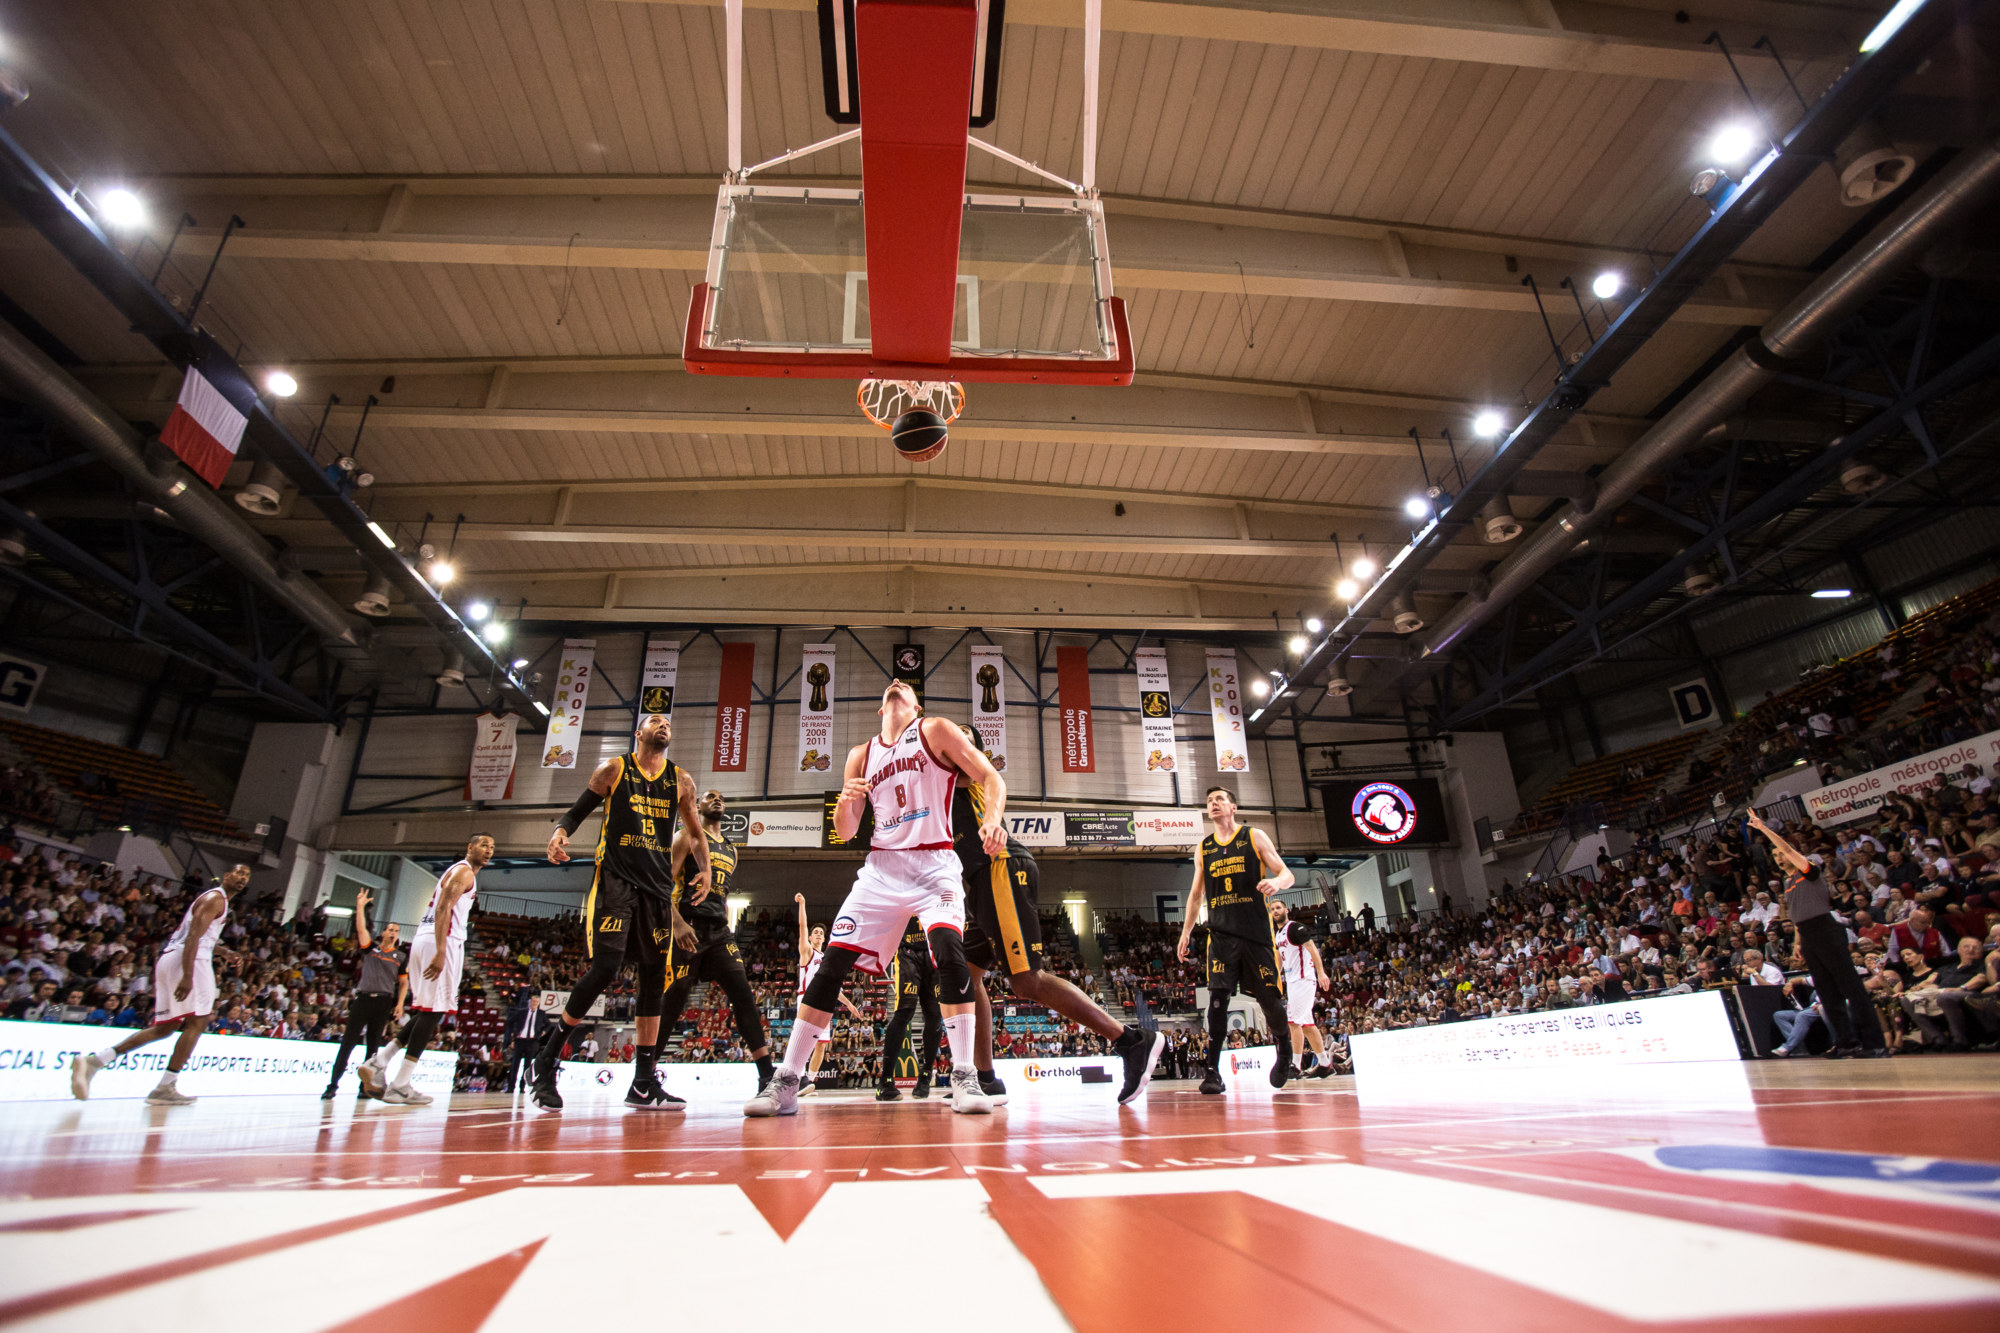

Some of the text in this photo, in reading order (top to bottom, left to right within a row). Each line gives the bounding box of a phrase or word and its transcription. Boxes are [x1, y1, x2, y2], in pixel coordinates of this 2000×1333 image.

[568, 666, 588, 727] 2002
[1225, 674, 1241, 732] 2002
[1673, 684, 1713, 724] D
[492, 730, 502, 742] 7
[718, 706, 733, 766] métropole
[730, 707, 747, 766] GrandNancy
[805, 729, 827, 737] 2008
[806, 737, 827, 746] 2011
[980, 730, 1000, 738] 2008
[984, 738, 1001, 746] 011
[1063, 708, 1078, 767] métropole
[1079, 709, 1088, 767] GrandNancy
[895, 757, 925, 773] NANCY
[1891, 747, 1978, 783] métropole
[895, 784, 906, 808] 8
[1809, 777, 1881, 808] métropole
[1815, 793, 1887, 821] GrandNancy
[641, 818, 656, 836] 15
[1011, 817, 1052, 834] TFN
[1015, 871, 1027, 885] 12
[1224, 877, 1232, 892] 8
[1156, 895, 1179, 923] F
[832, 923, 854, 931] cora
[1497, 1018, 1560, 1038] Charpentes
[254, 1058, 268, 1073] LE
[270, 1058, 300, 1074] SLUC
[633, 1171, 720, 1179] de
[756, 1151, 1349, 1179] NATIONALE
